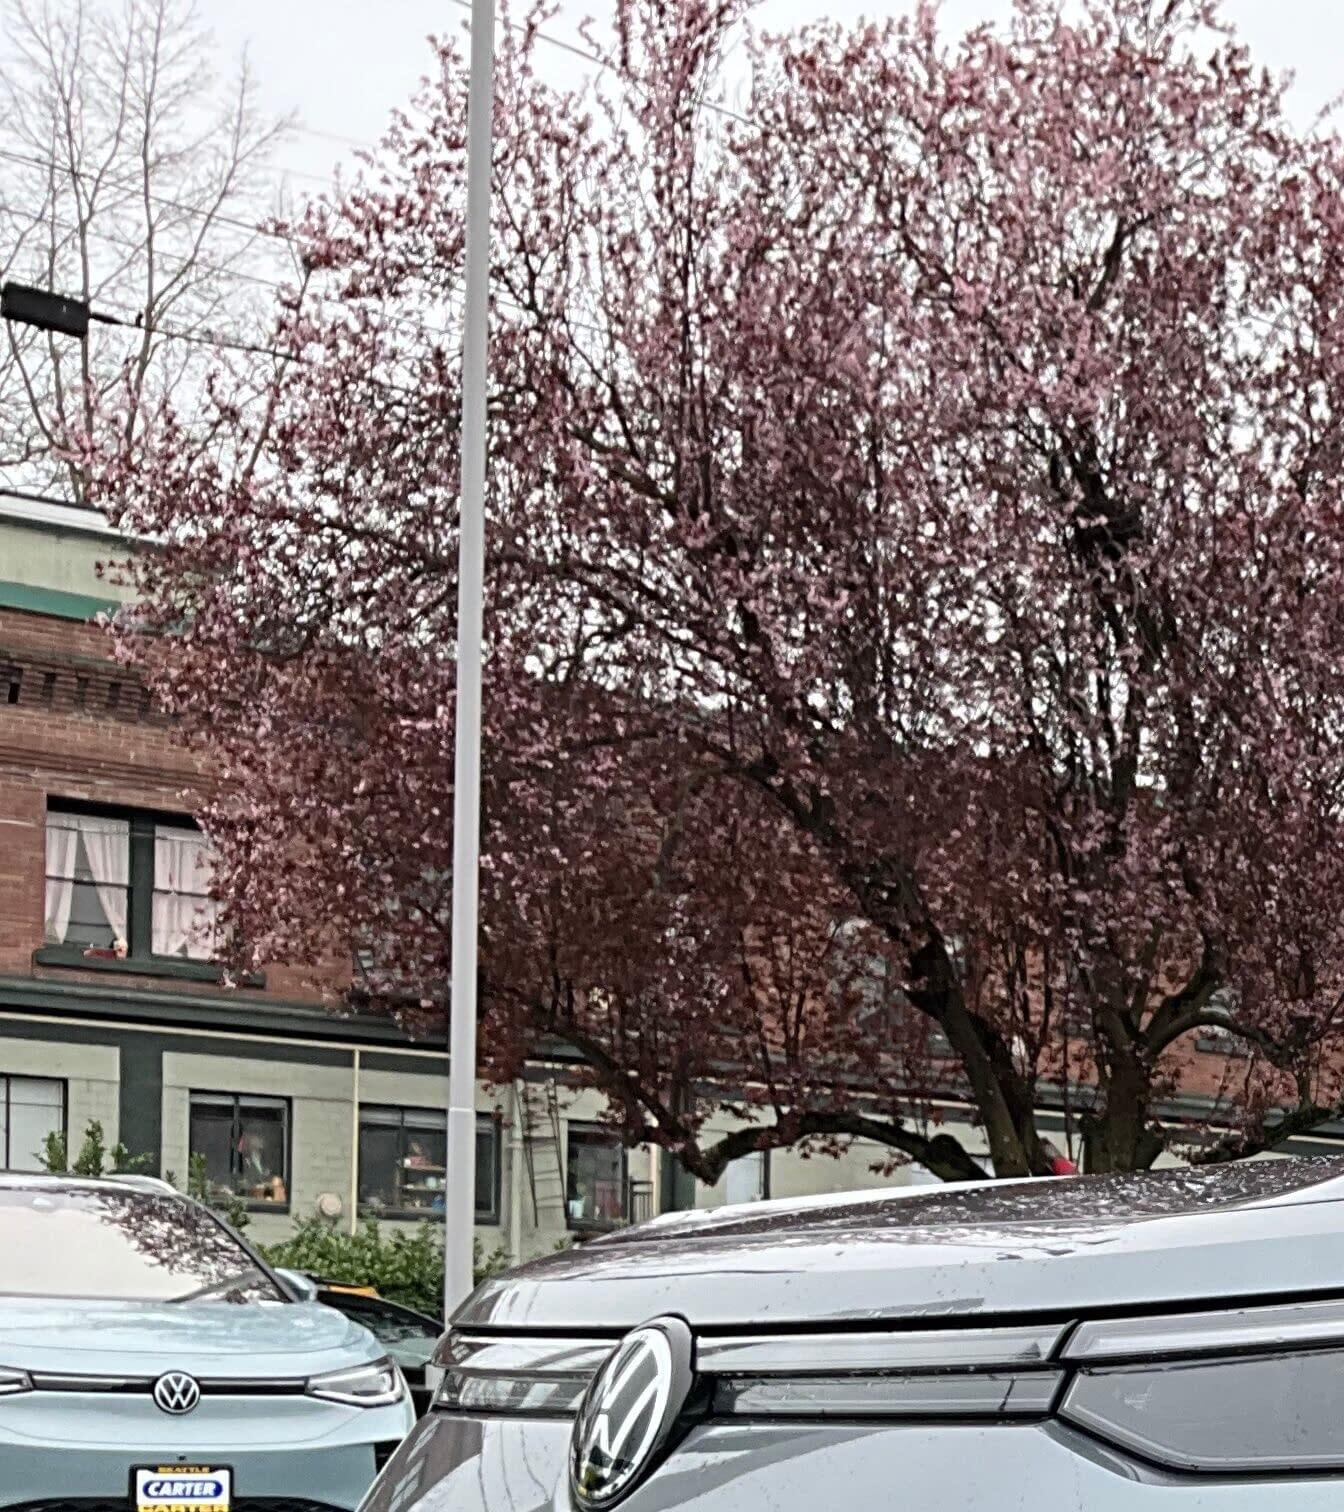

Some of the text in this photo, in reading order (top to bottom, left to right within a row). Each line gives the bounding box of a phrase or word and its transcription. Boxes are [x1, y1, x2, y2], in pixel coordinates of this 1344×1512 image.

[154, 1372, 200, 1413] VW
[147, 1482, 216, 1496] CARTER
[138, 1504, 229, 1512] CARTER
